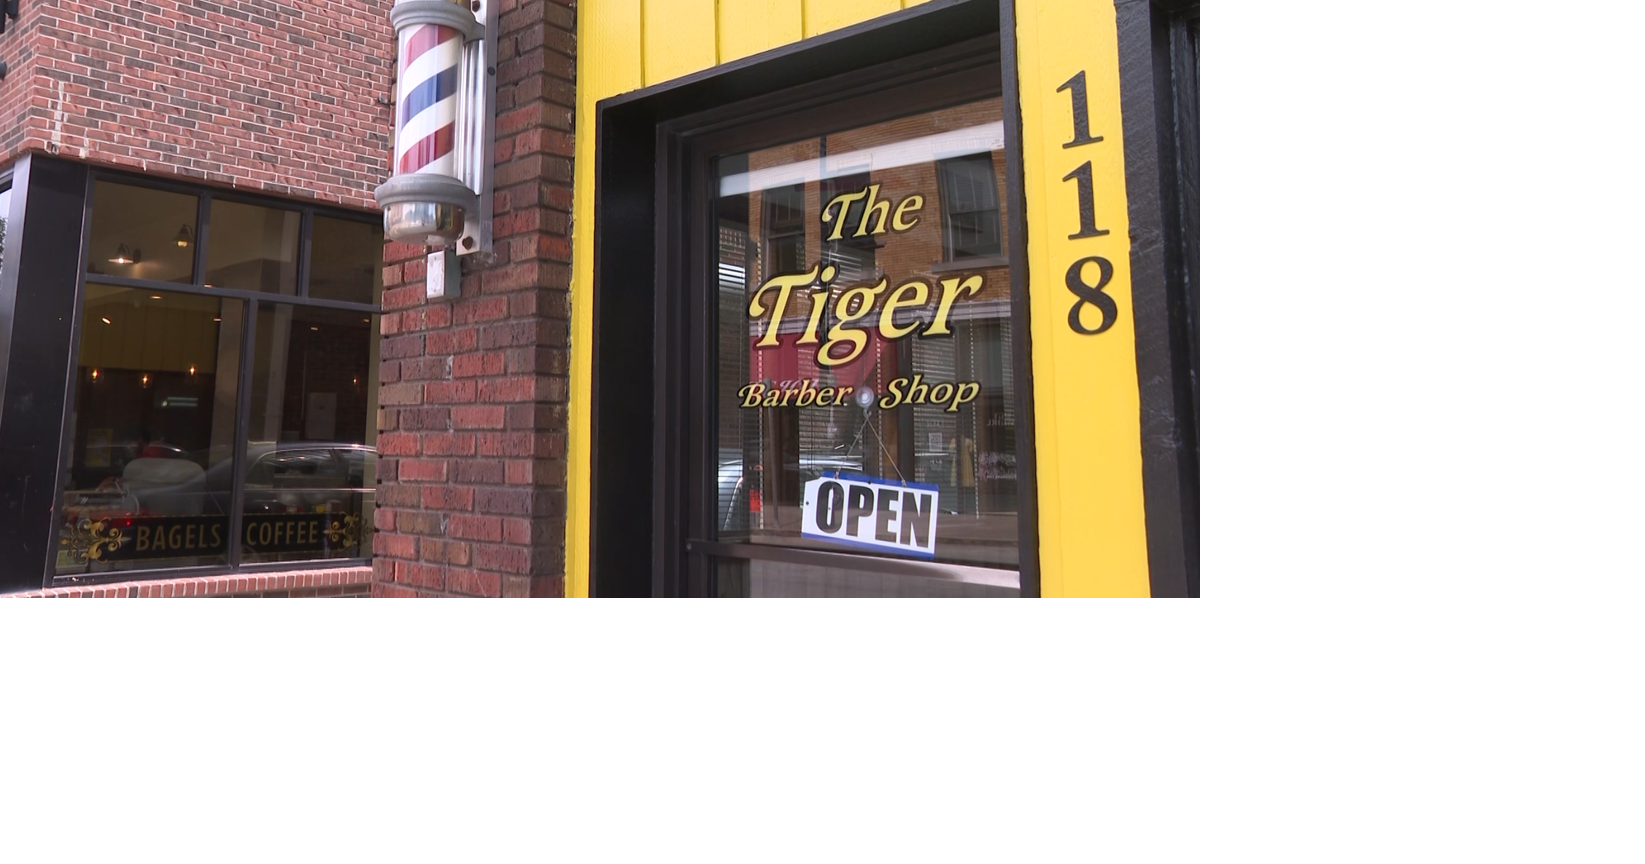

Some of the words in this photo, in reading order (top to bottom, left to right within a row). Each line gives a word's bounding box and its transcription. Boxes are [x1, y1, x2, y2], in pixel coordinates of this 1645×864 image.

[820, 183, 925, 242] The
[1056, 69, 1118, 336] 118
[748, 264, 984, 367] Tiger
[738, 378, 853, 408] Barber
[879, 374, 980, 412] Shop
[136, 522, 222, 551] BAGELS
[246, 520, 319, 546] COFFEE
[816, 480, 932, 548] OPEN
